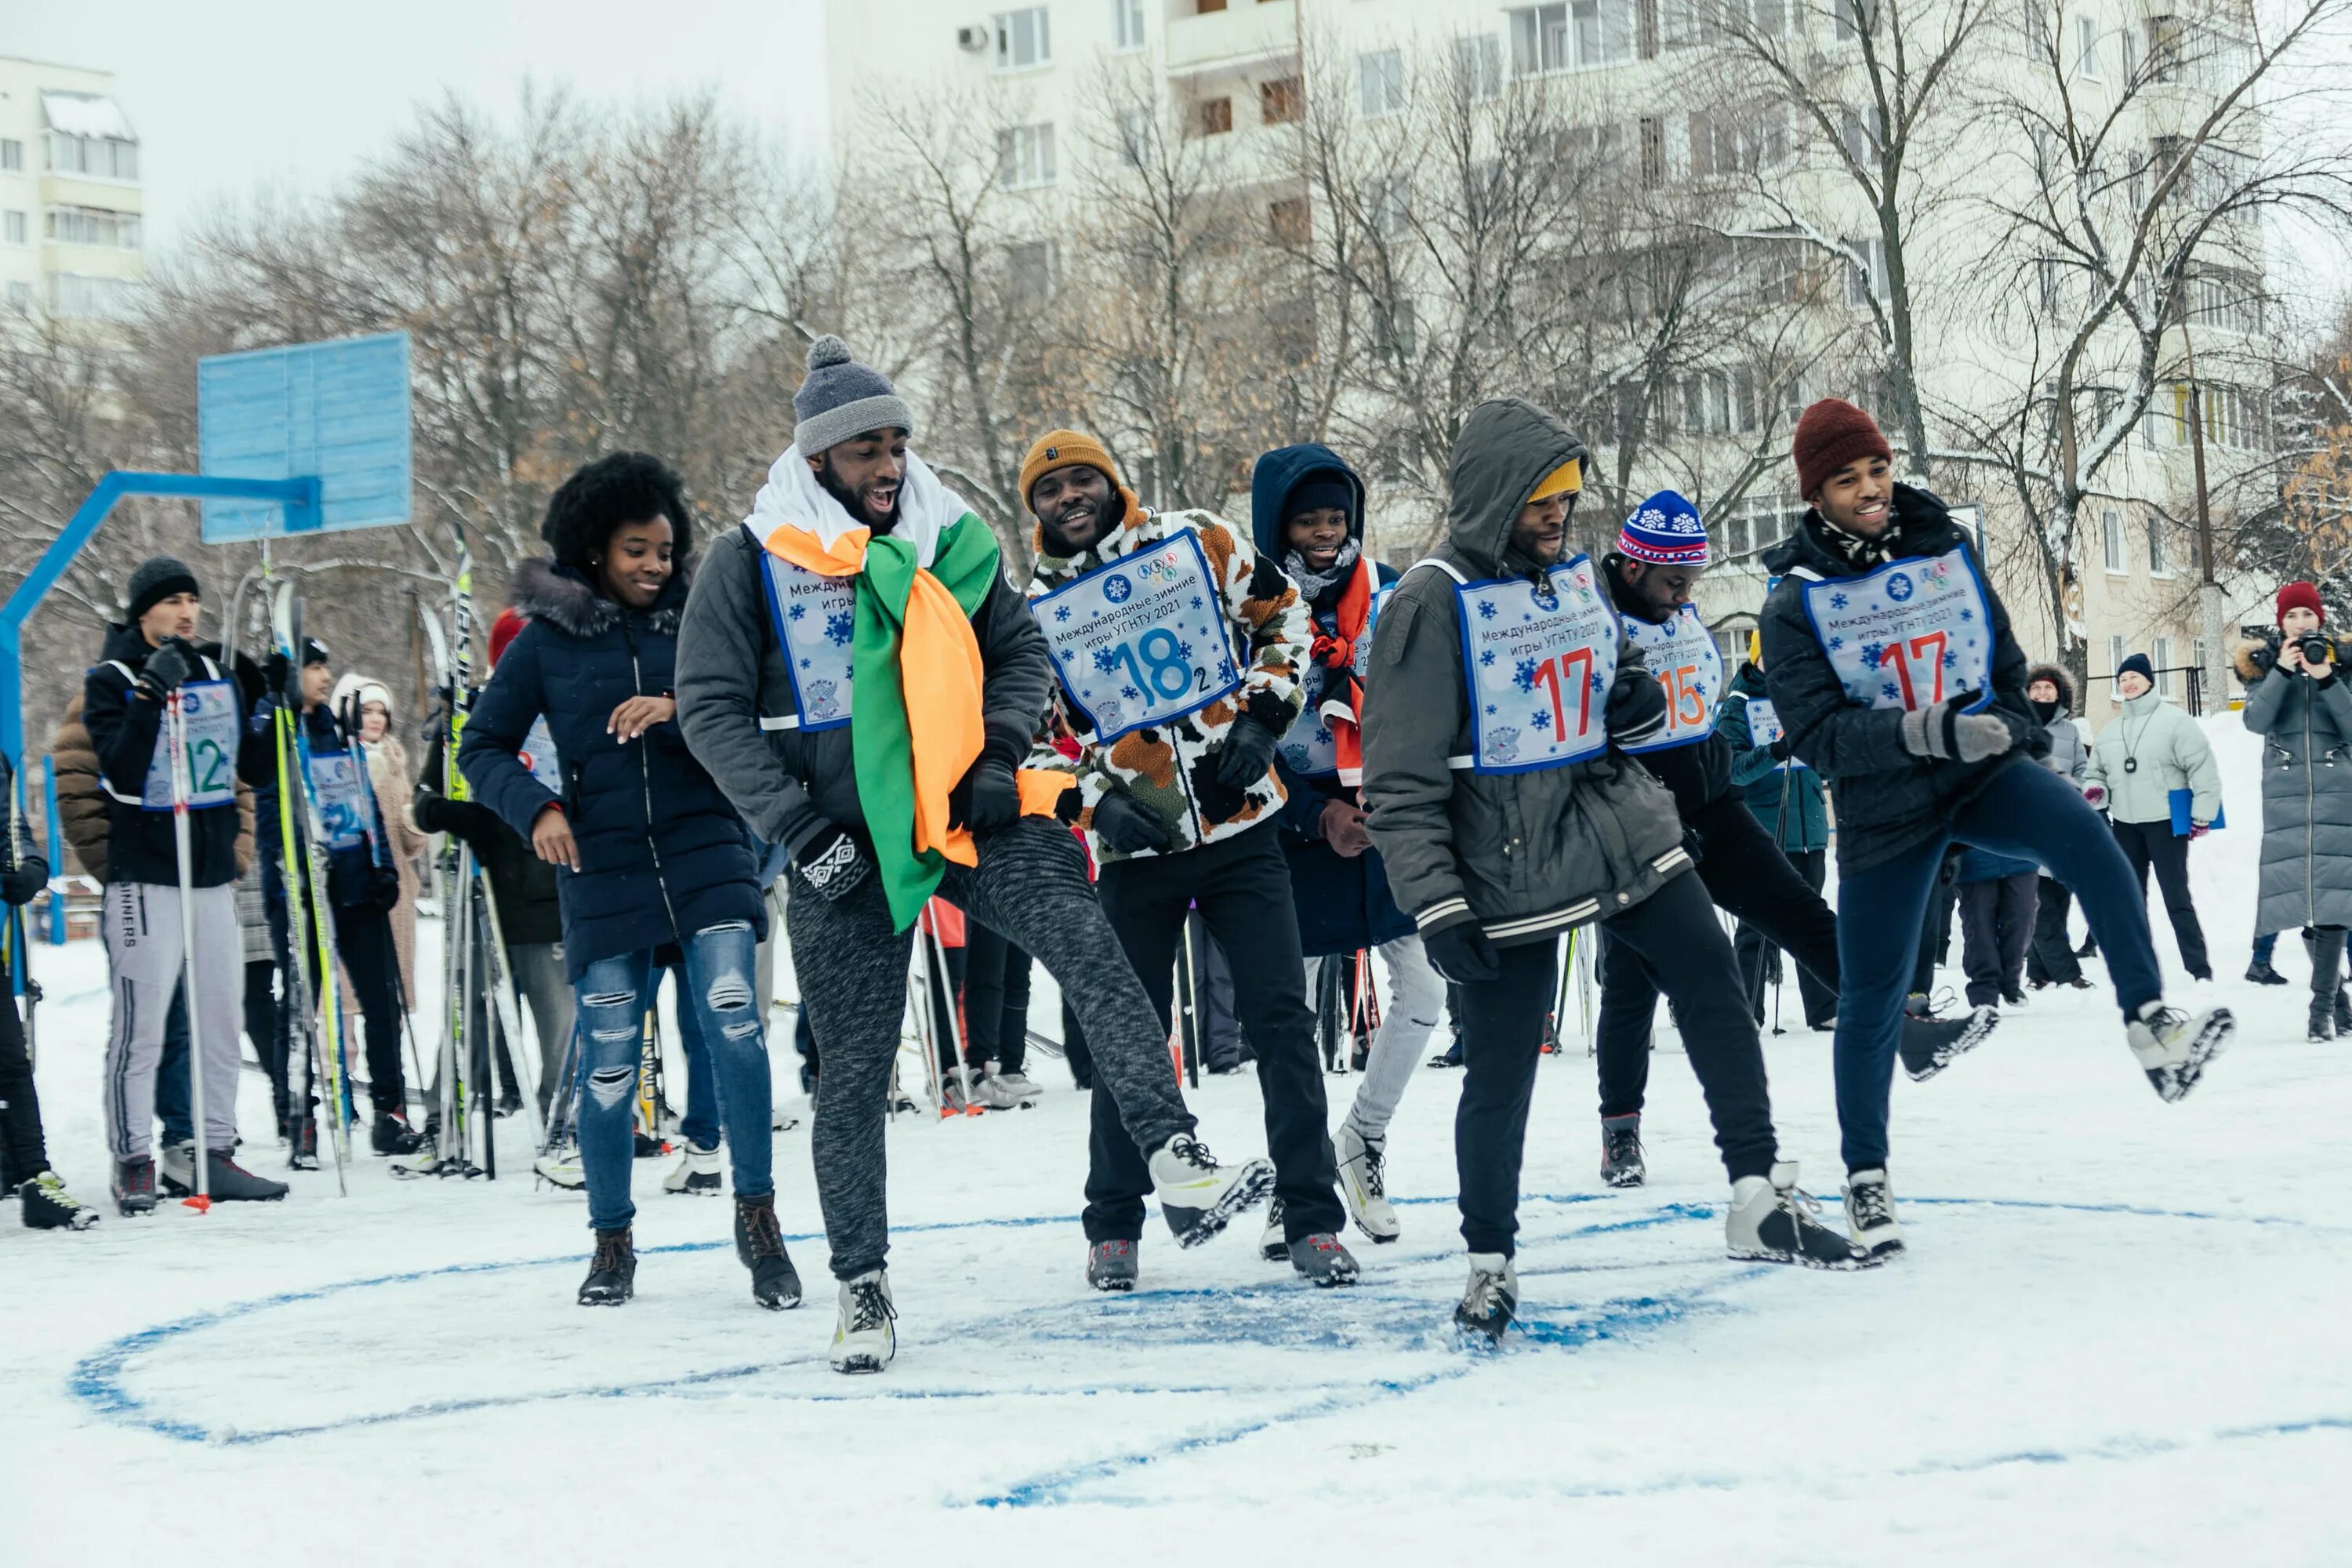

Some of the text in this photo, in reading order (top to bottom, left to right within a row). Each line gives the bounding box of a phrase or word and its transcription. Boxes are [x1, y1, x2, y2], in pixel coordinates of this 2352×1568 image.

[789, 581, 855, 598] Междуна
[822, 597, 856, 610] игры
[1055, 575, 1196, 644] Международные зимние
[1083, 599, 1181, 650] игры УГНТУ 2021
[1482, 612, 1578, 643] Международные
[1510, 621, 1600, 656] игры УГНТУ 2021
[1829, 602, 1926, 632] Международные
[1857, 628, 1889, 641] игры
[1928, 608, 1952, 624] 2021
[1112, 628, 1192, 707] 18
[1193, 666, 1211, 693] 2
[1879, 630, 1947, 712] 17
[1533, 647, 1593, 742] 17
[1657, 665, 1705, 731] 15
[642, 1038, 656, 1100] OMNI
